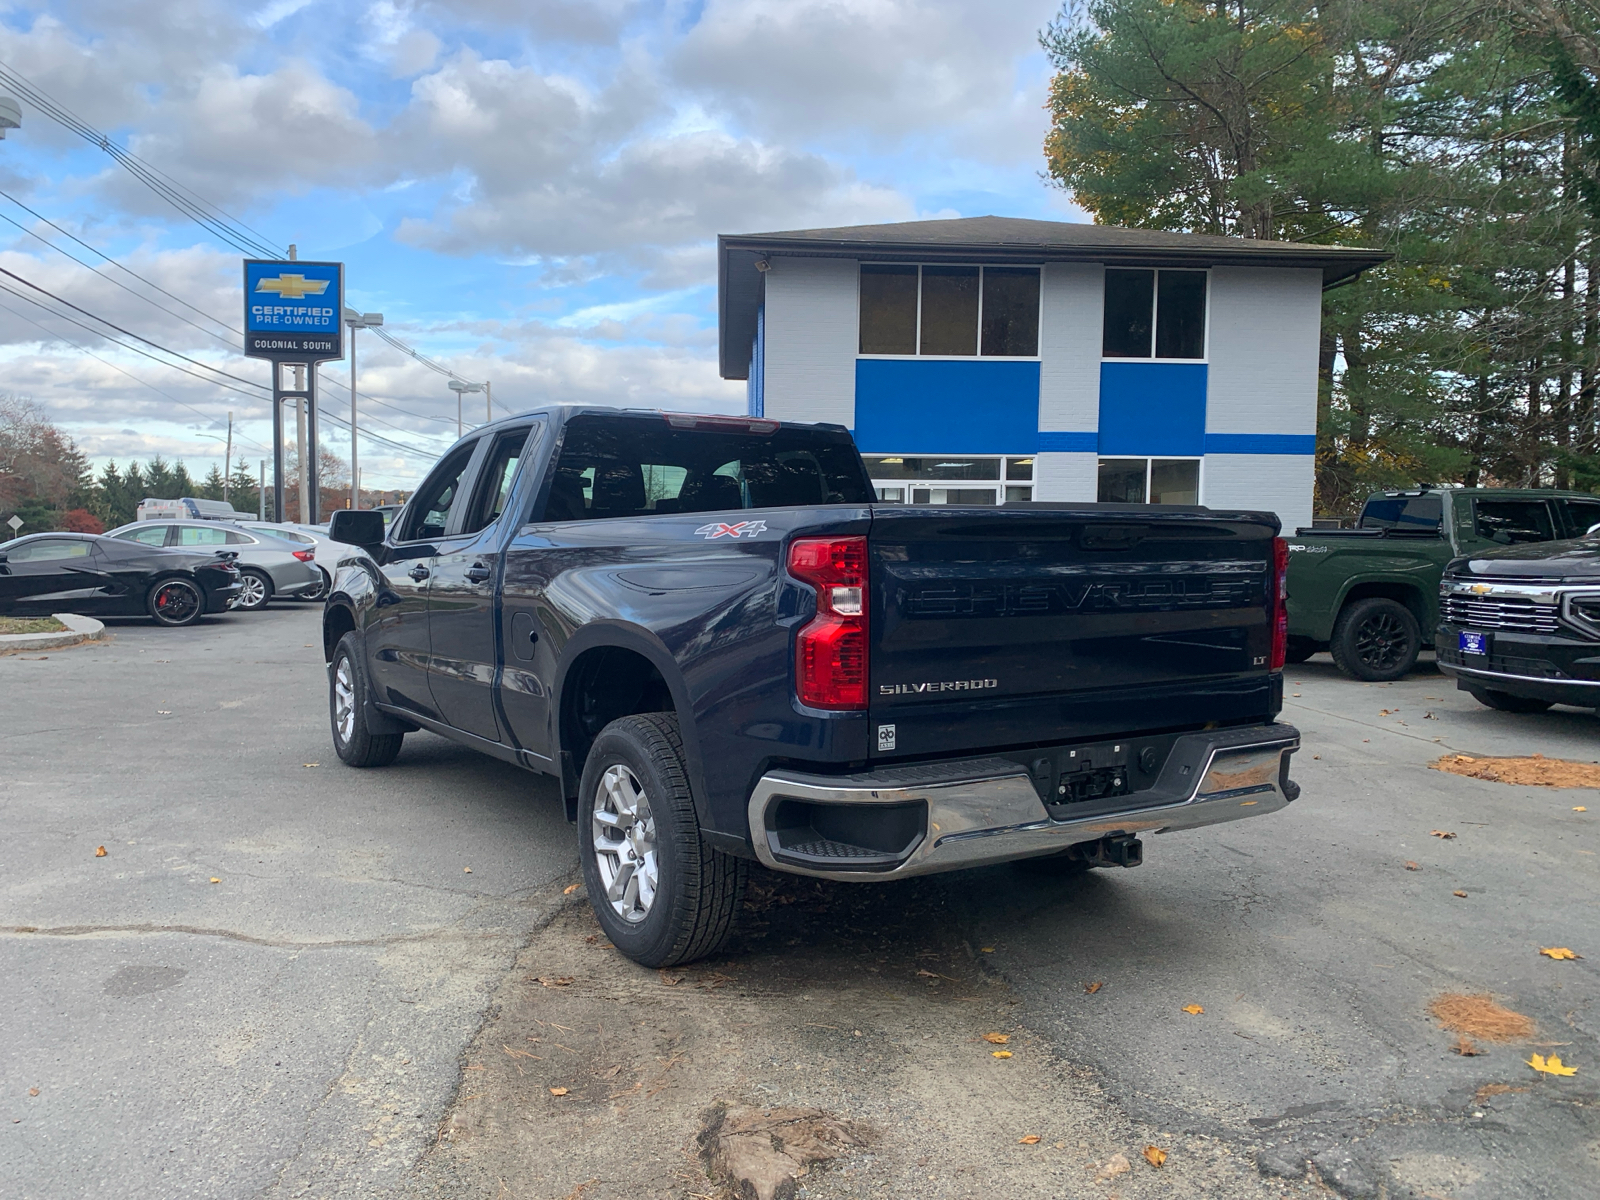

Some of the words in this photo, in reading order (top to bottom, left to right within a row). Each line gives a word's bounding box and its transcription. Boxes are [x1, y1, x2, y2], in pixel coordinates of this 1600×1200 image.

[252, 305, 334, 317] CERTIFIED
[256, 315, 330, 326] PRE-OWNED
[254, 340, 298, 349] COLONIAL
[303, 341, 332, 350] SOUTH
[906, 578, 1261, 613] CHEVROLET
[1253, 655, 1267, 666] LT
[879, 679, 998, 695] SILVERADO
